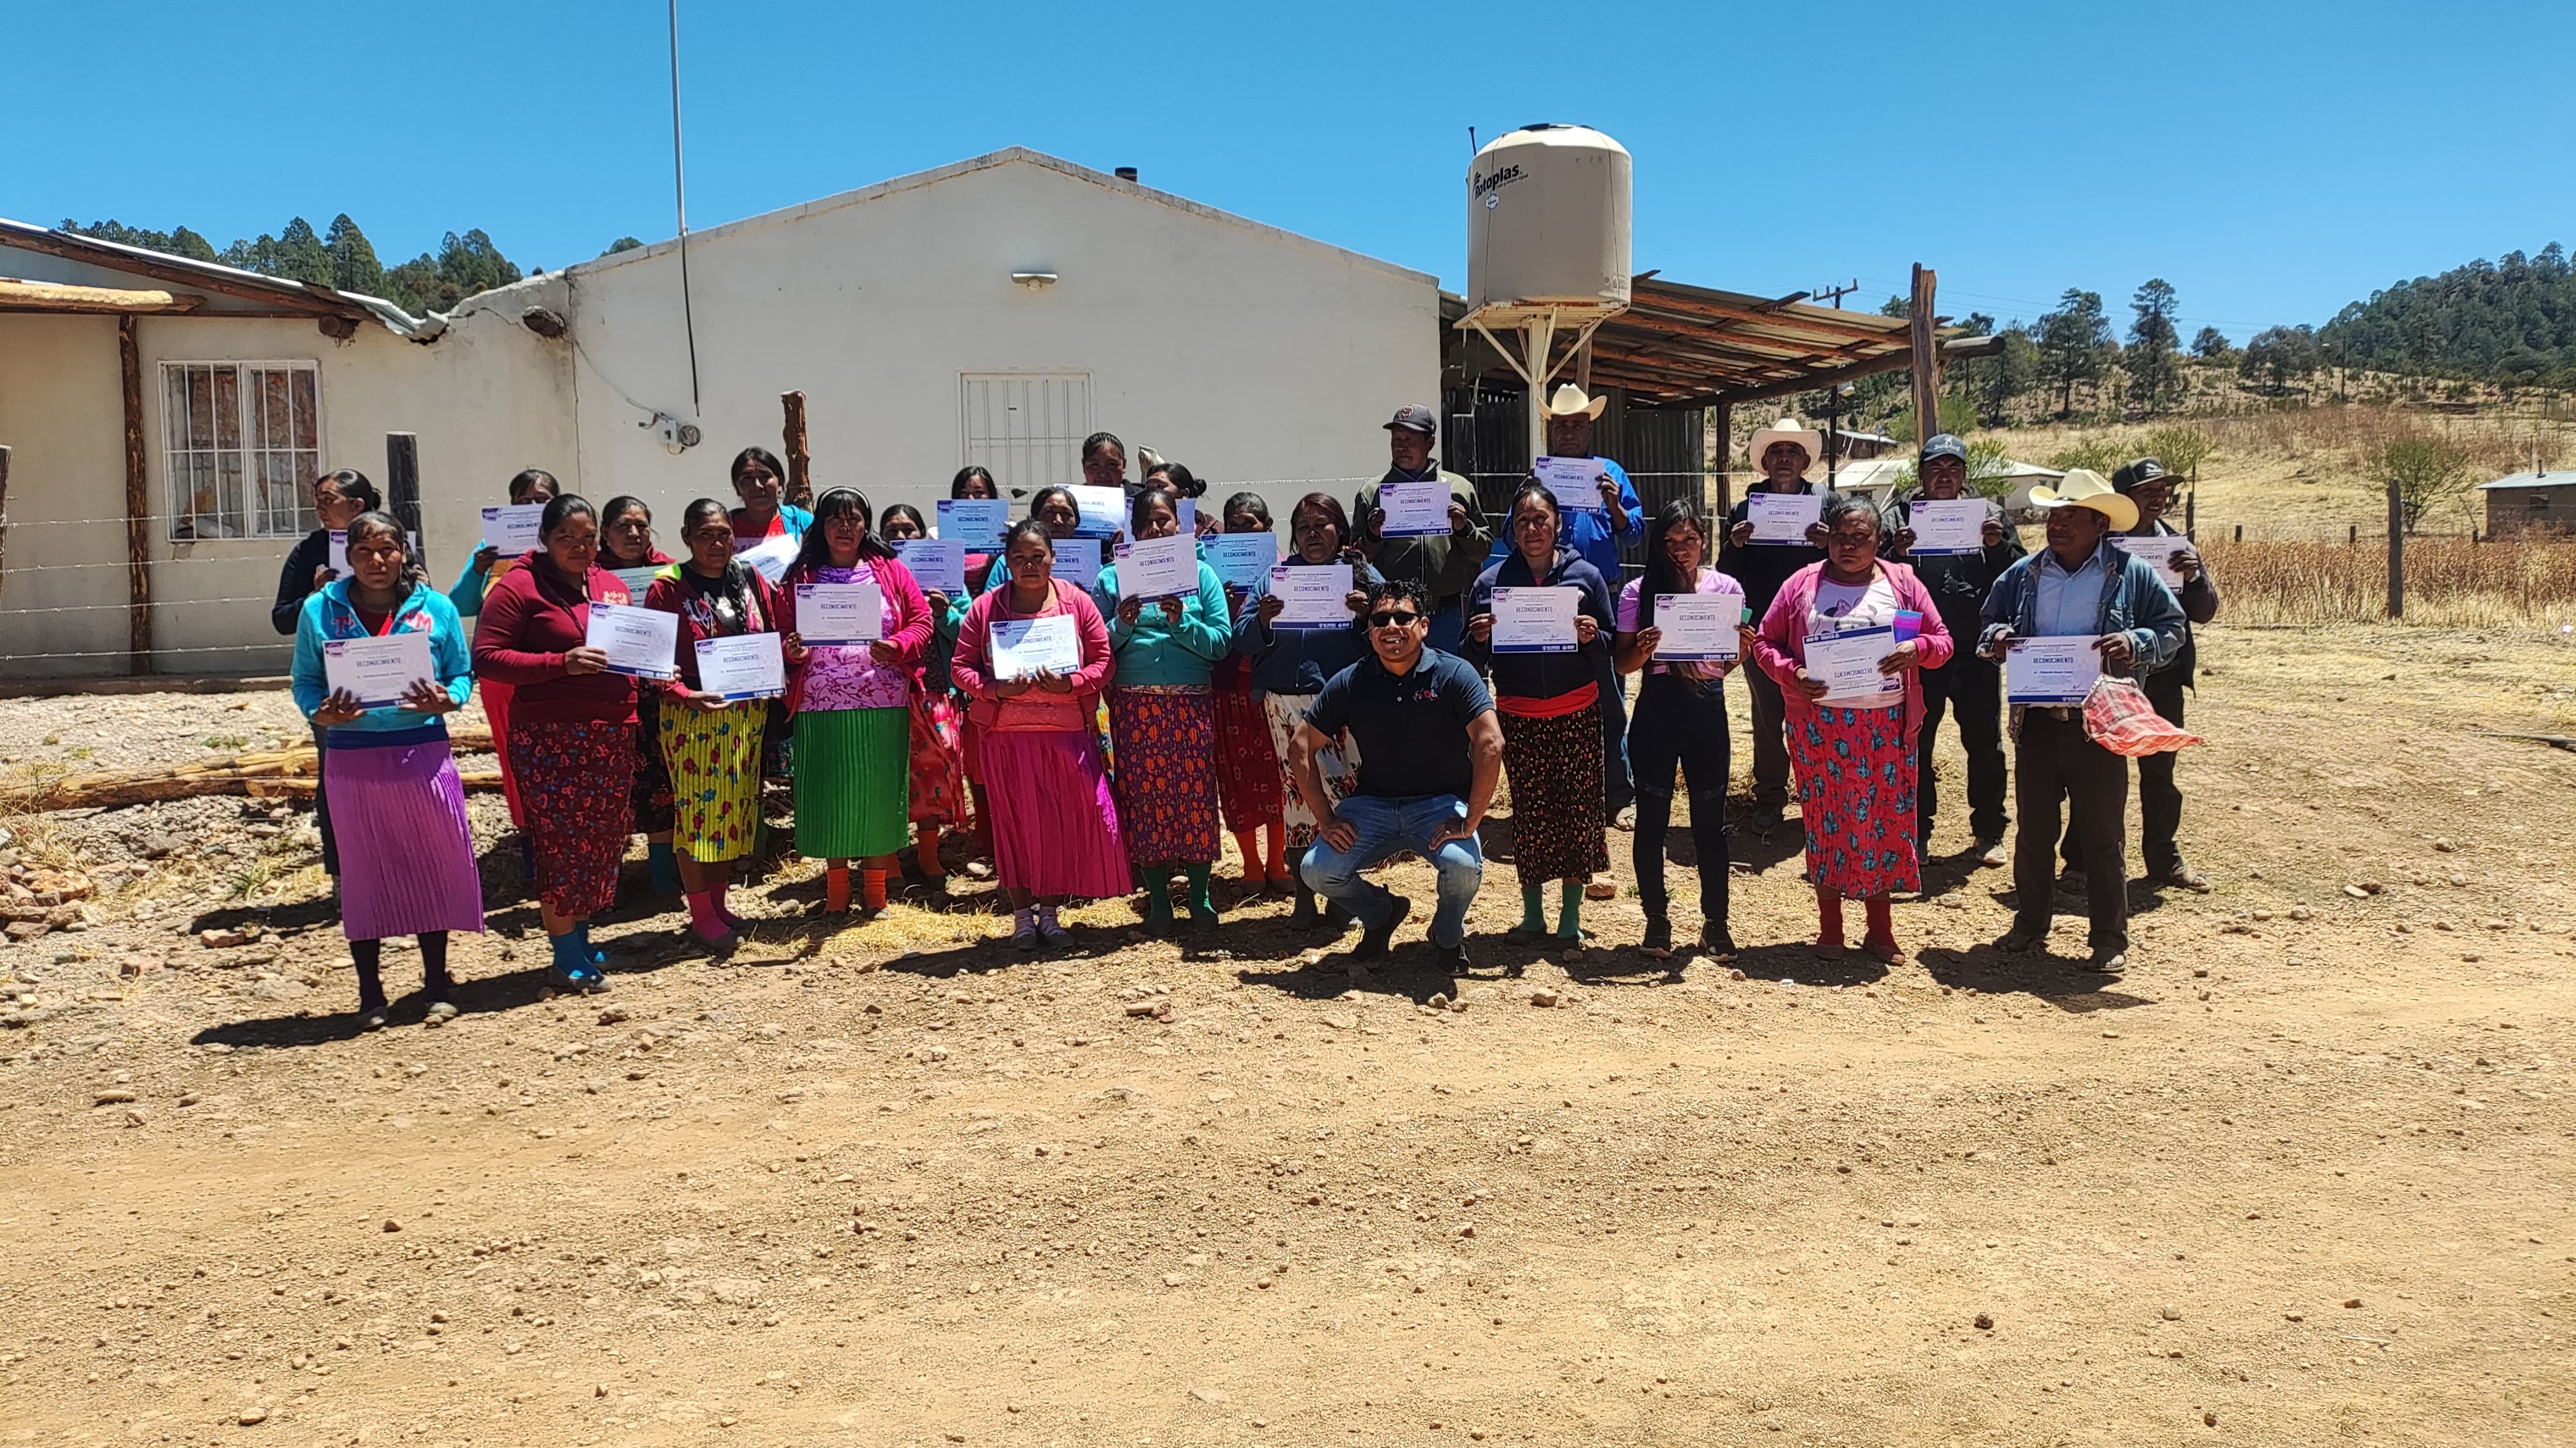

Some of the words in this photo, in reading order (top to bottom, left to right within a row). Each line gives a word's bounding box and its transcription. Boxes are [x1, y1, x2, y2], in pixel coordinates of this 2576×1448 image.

[1474, 165, 1520, 201] Rotoplas
[1139, 556, 1175, 567] RECONOCIMIENTO
[1016, 635, 1052, 644] RECONOCIMIENTO
[356, 657, 401, 667] RECONOCIMIENTO
[723, 654, 760, 663] RECONOCIMIENTO
